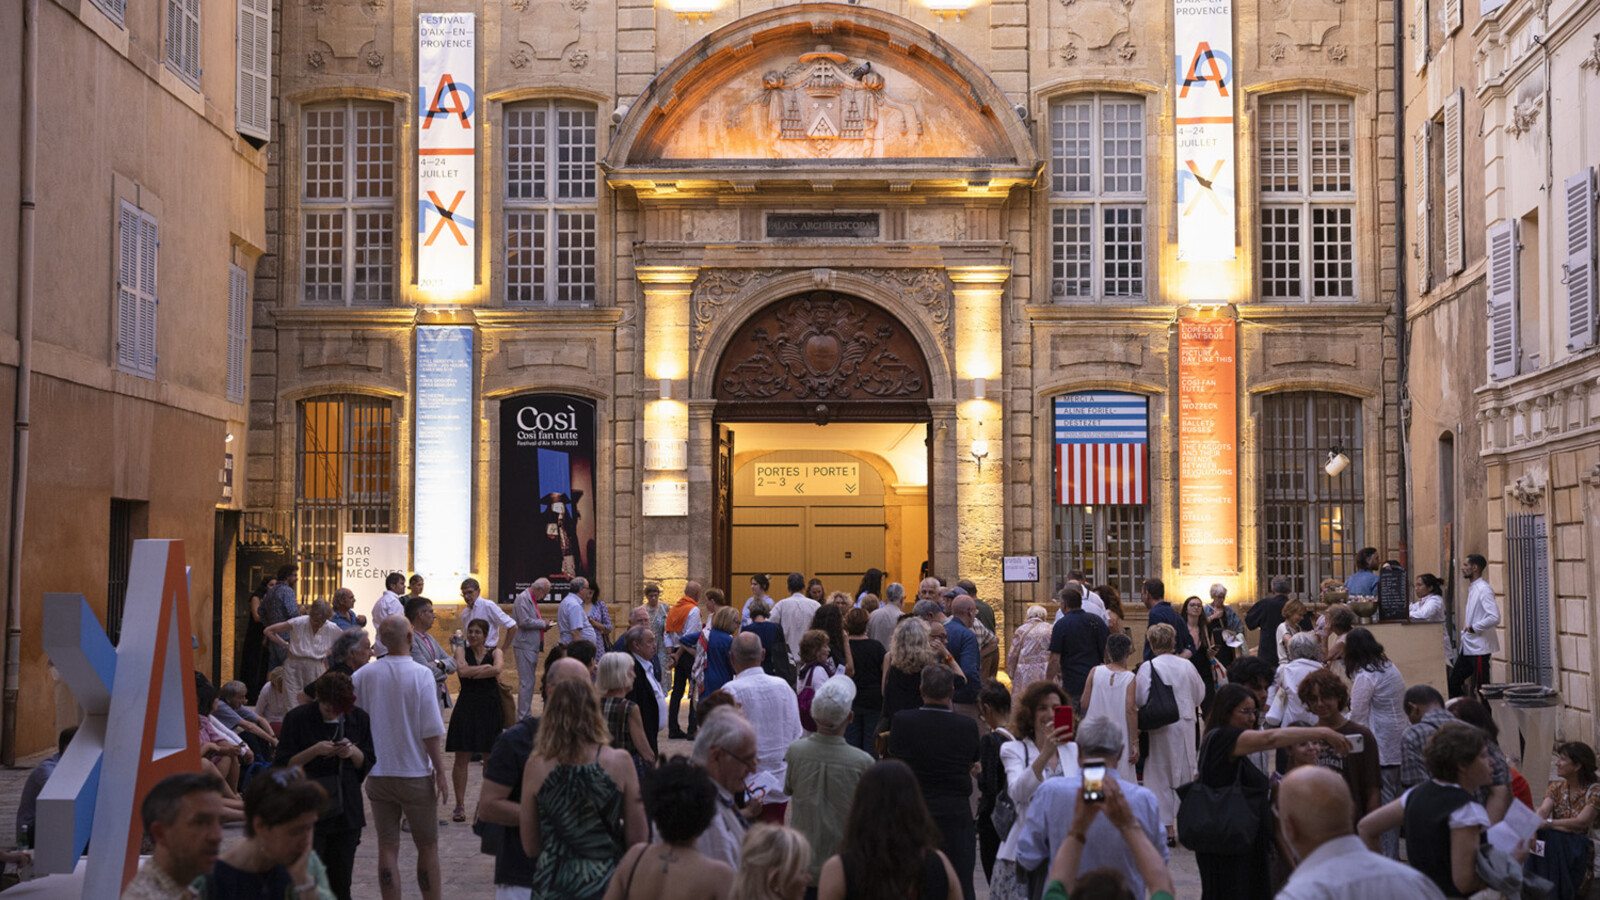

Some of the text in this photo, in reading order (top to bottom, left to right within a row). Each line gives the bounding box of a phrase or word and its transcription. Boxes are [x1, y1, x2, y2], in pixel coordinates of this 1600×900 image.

[1176, 6, 1229, 15] PROVENCE
[420, 40, 472, 48] PROVENCE
[1178, 138, 1217, 148] JUILLET
[420, 169, 459, 178] JUILLET
[516, 404, 578, 431] Così
[516, 430, 578, 440] Così fan tutte
[757, 466, 800, 476] PORTES
[813, 466, 856, 476] PORTE 1
[757, 477, 764, 487] 2
[779, 477, 786, 487] 3
[347, 546, 371, 555] BAR
[346, 557, 370, 567] DES
